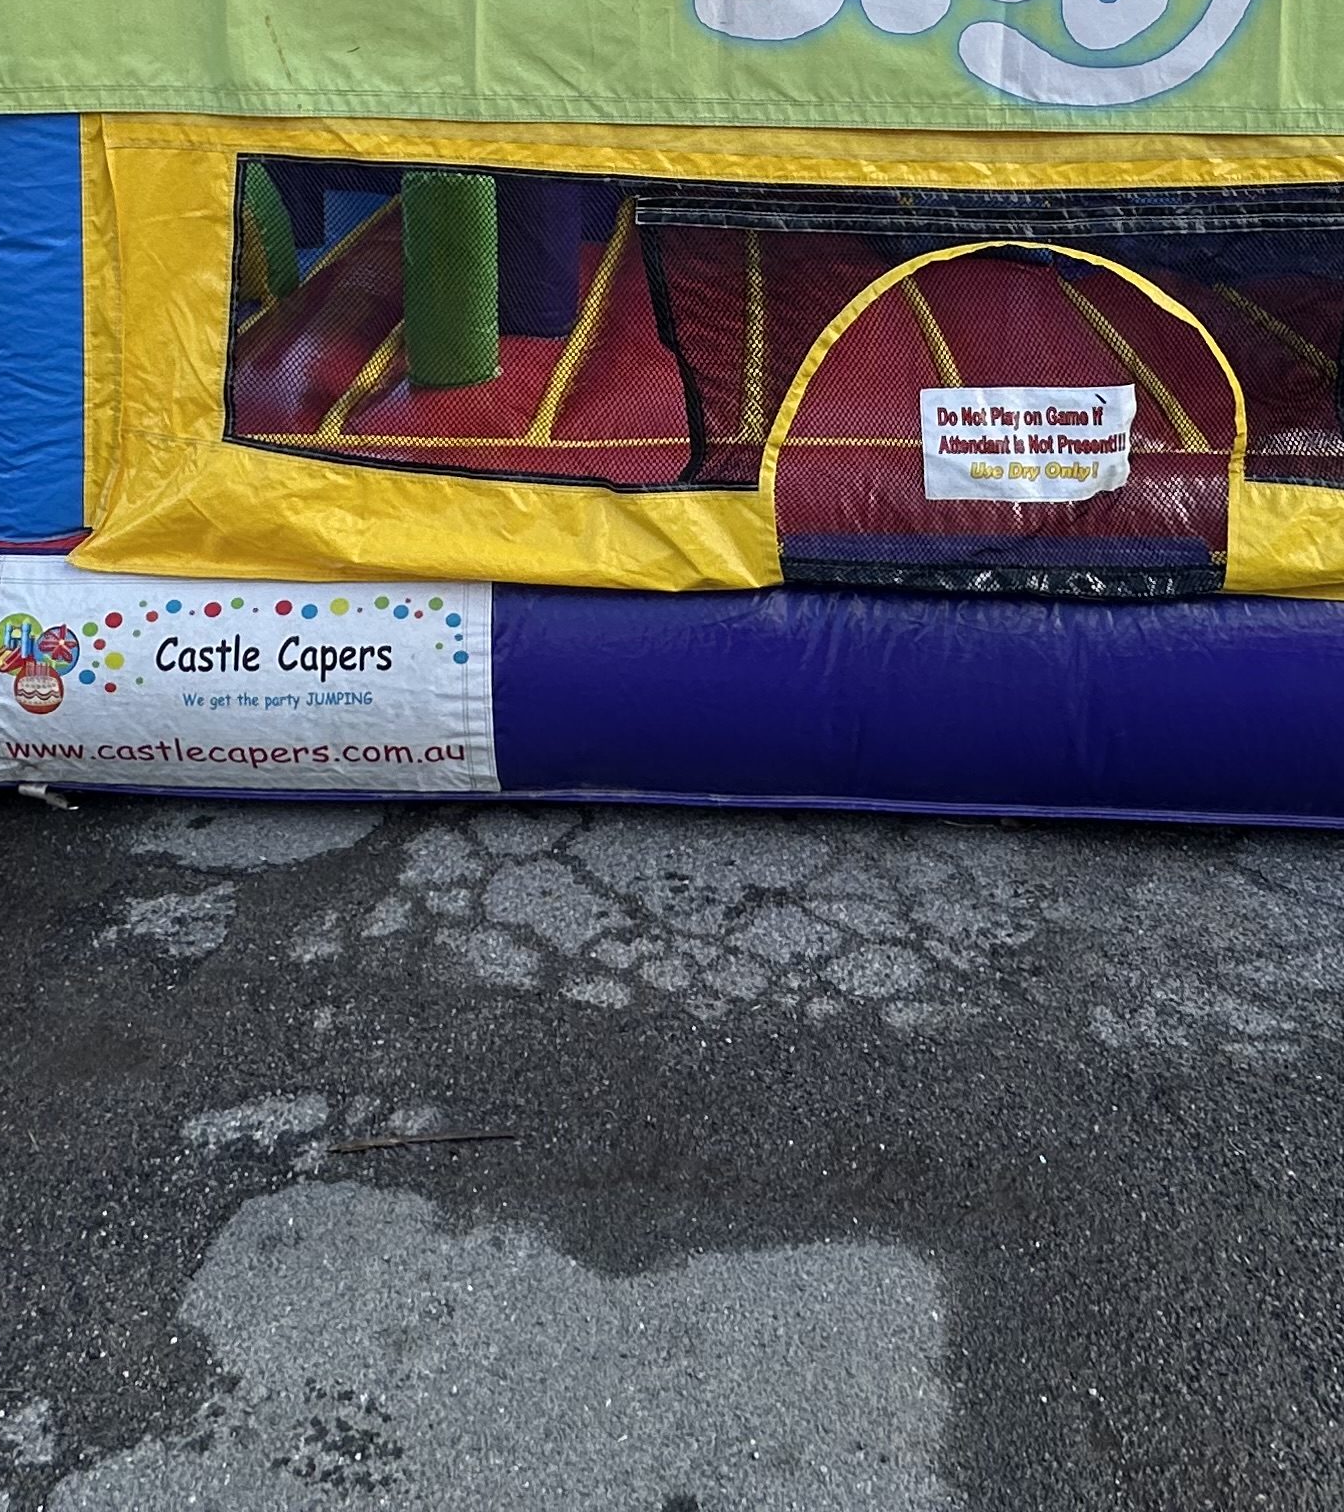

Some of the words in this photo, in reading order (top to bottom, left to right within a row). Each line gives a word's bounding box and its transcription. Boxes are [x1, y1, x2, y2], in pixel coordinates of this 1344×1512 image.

[937, 406, 958, 427] Do
[961, 406, 986, 427] Not
[990, 406, 1020, 430] Play
[1023, 409, 1043, 426] on
[1045, 406, 1089, 426] Game
[939, 434, 1011, 455] Attendant
[1028, 434, 1055, 454] Not
[969, 461, 1003, 480] Use
[1008, 461, 1040, 481] Dry
[1045, 461, 1099, 481] Only!
[155, 634, 261, 673] Castle
[277, 636, 393, 682] Capers
[182, 692, 205, 707] We
[209, 693, 232, 710] get
[237, 692, 259, 706] the
[264, 693, 301, 710] party
[306, 691, 373, 707] JUMPING
[5, 737, 466, 770] www.castlecapers.com.au
